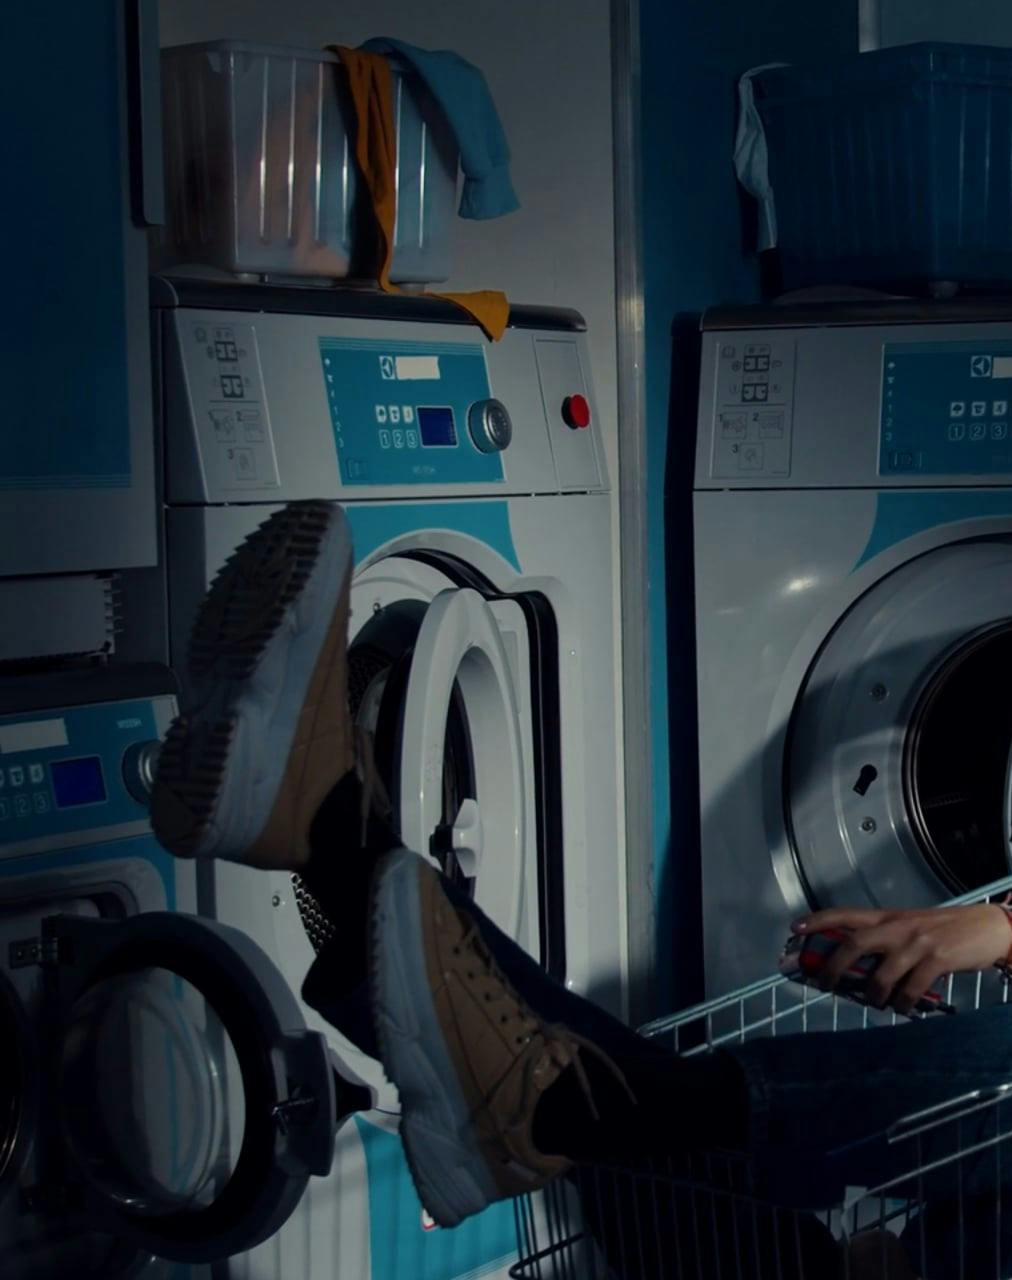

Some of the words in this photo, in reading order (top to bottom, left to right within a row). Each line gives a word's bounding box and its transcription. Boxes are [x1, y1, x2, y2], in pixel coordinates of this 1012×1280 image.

[952, 425, 960, 438] 1
[972, 425, 982, 438] 2
[993, 424, 1003, 437] 3
[382, 434, 389, 445] 1
[395, 433, 403, 445] 2
[409, 433, 416, 445] 3
[19, 798, 28, 813] 2
[38, 795, 46, 809] 3
